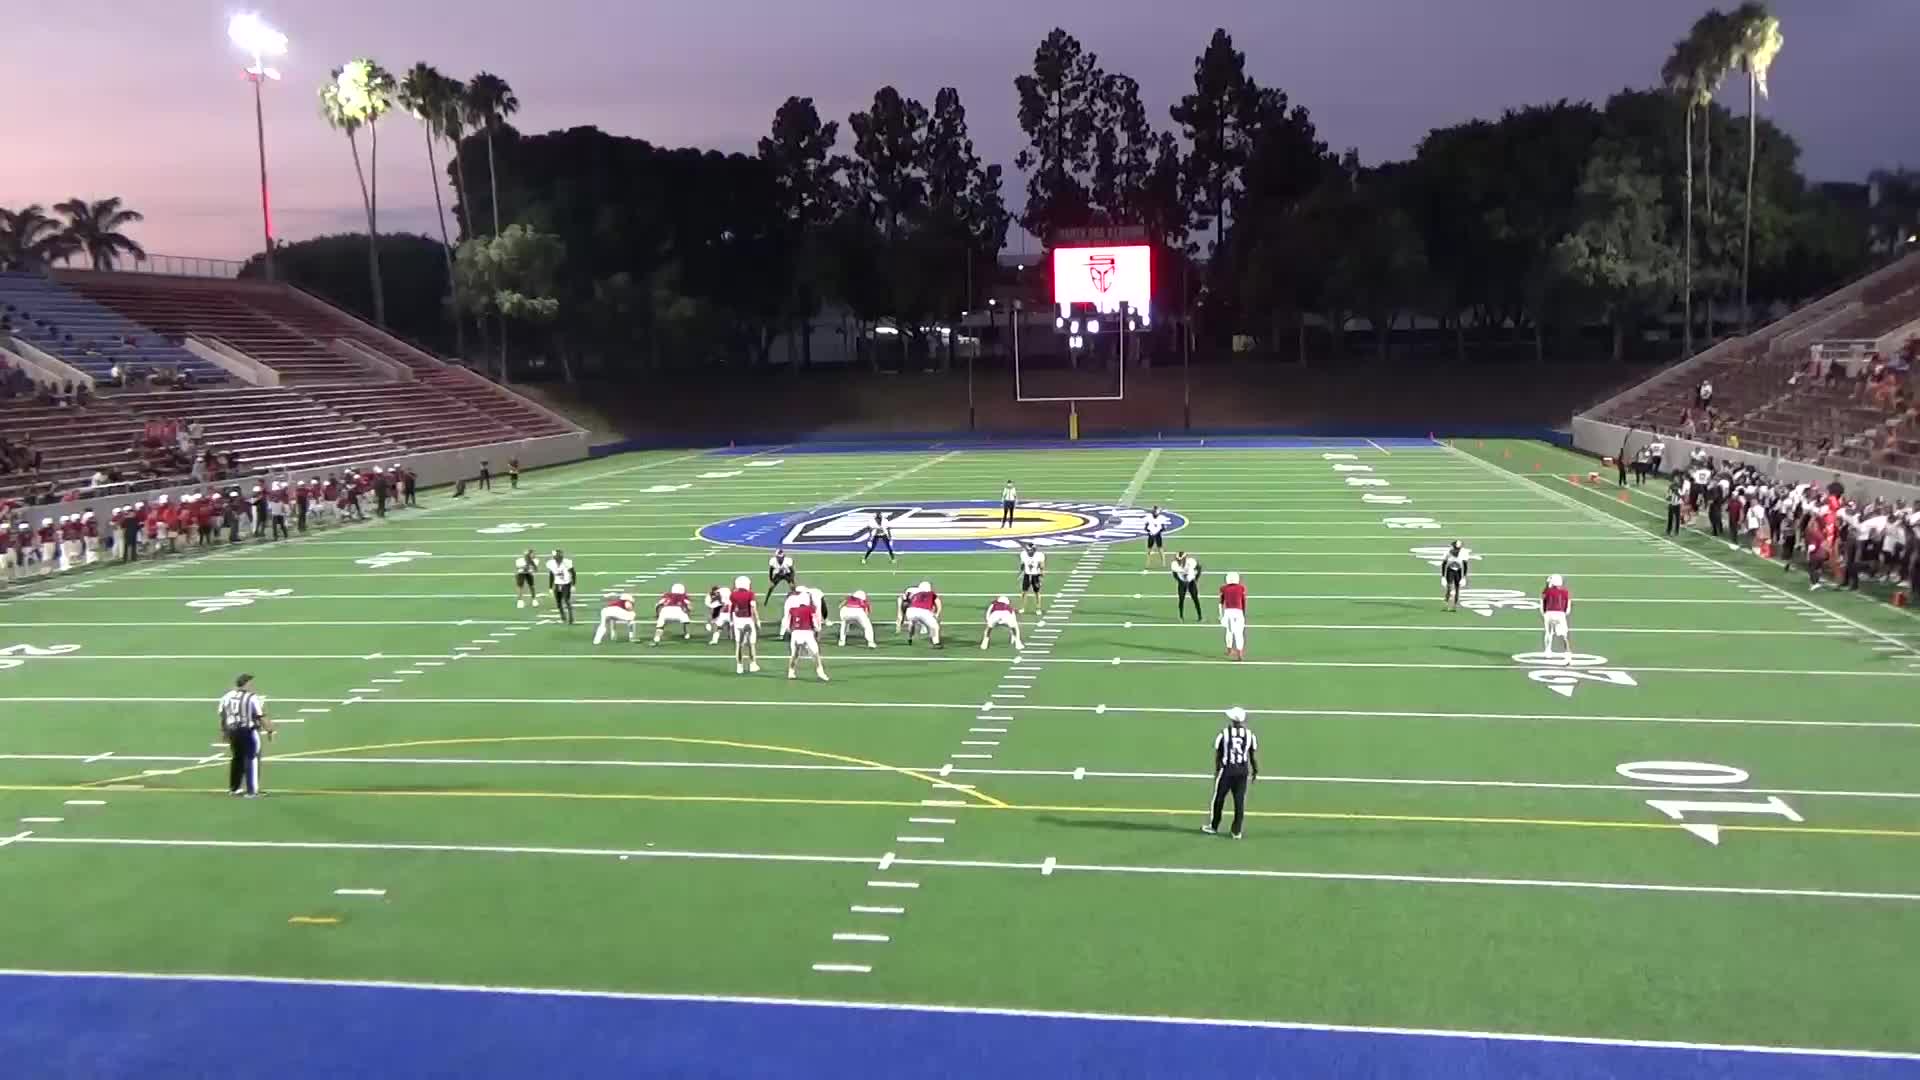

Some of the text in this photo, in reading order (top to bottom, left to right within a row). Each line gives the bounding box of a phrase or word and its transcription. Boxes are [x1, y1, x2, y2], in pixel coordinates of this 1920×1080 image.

[1512, 651, 1638, 686] 20
[1232, 737, 1243, 753] R
[1615, 761, 1805, 822] 10
